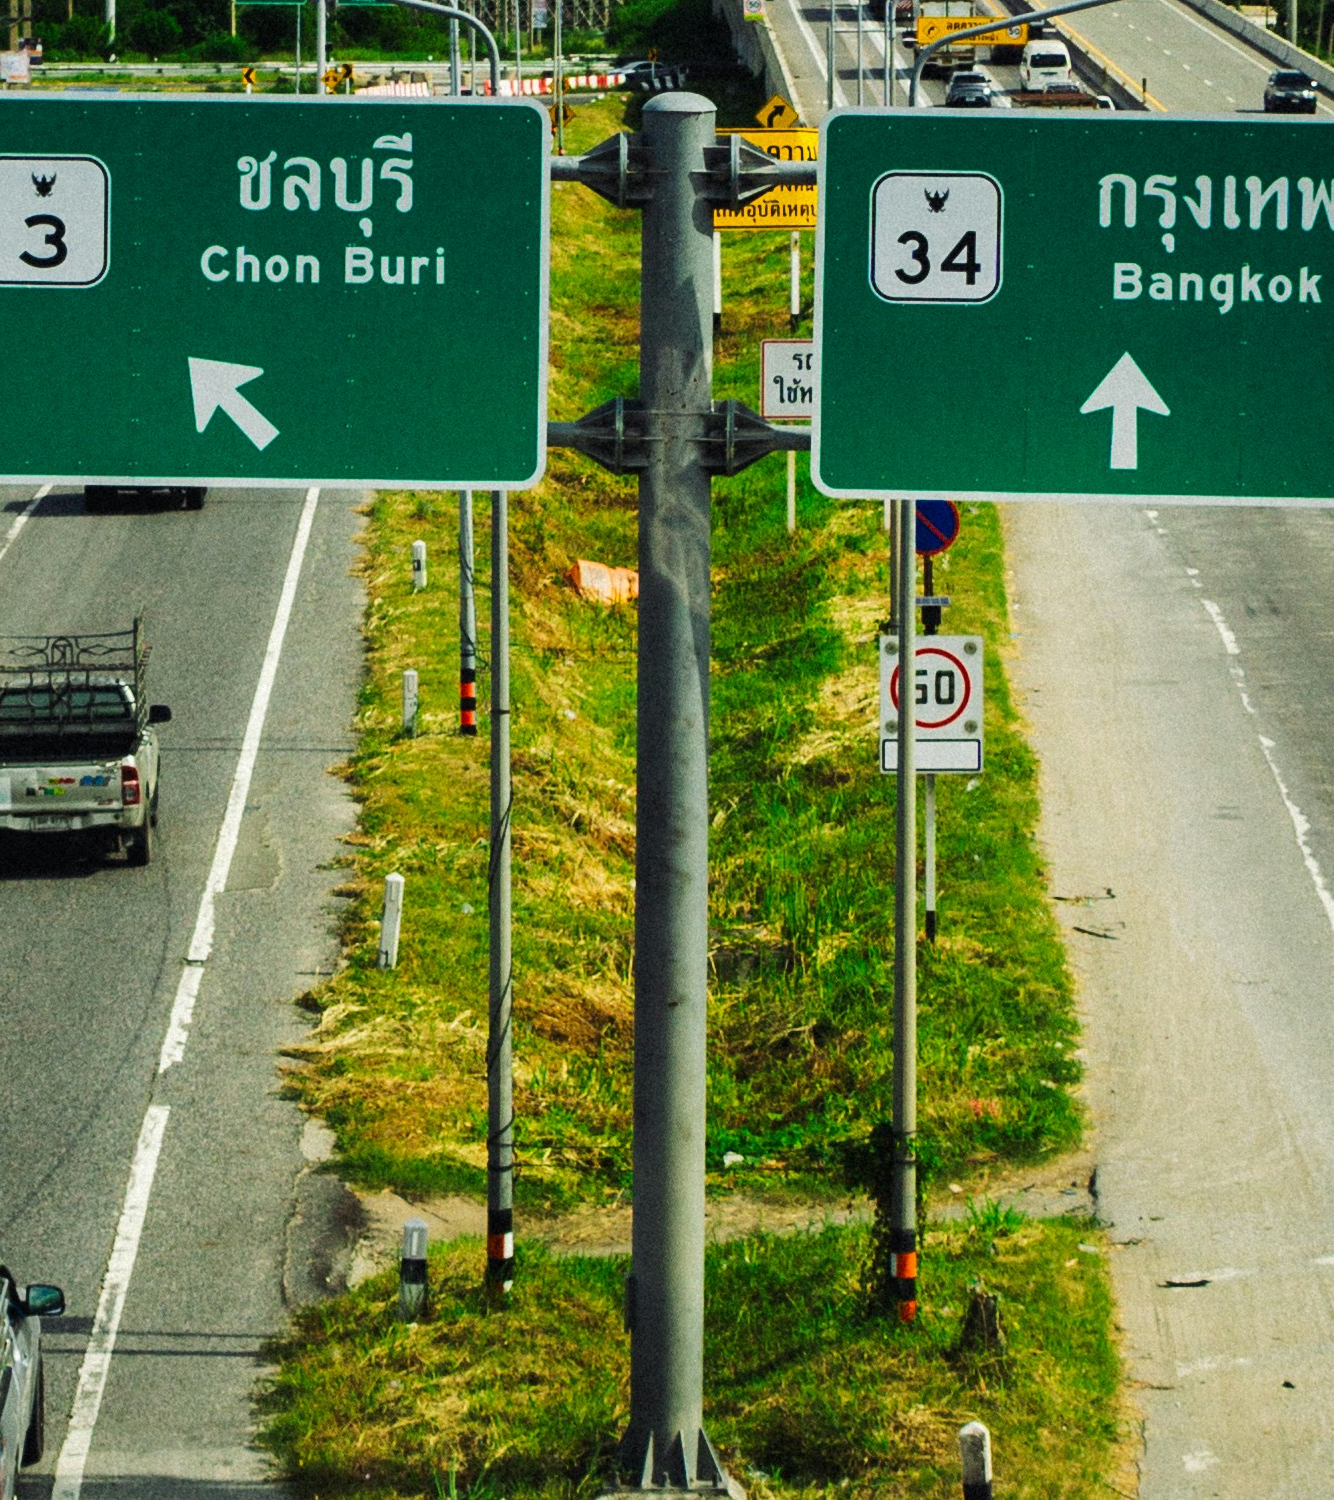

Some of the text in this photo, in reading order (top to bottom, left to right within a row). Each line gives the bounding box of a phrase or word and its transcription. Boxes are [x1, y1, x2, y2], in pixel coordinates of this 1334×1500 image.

[237, 132, 414, 238] ชลบุรี
[19, 213, 68, 269] 3
[200, 245, 446, 285] Chon Buri
[895, 230, 981, 286] 34
[1113, 262, 1322, 314] Bangkok
